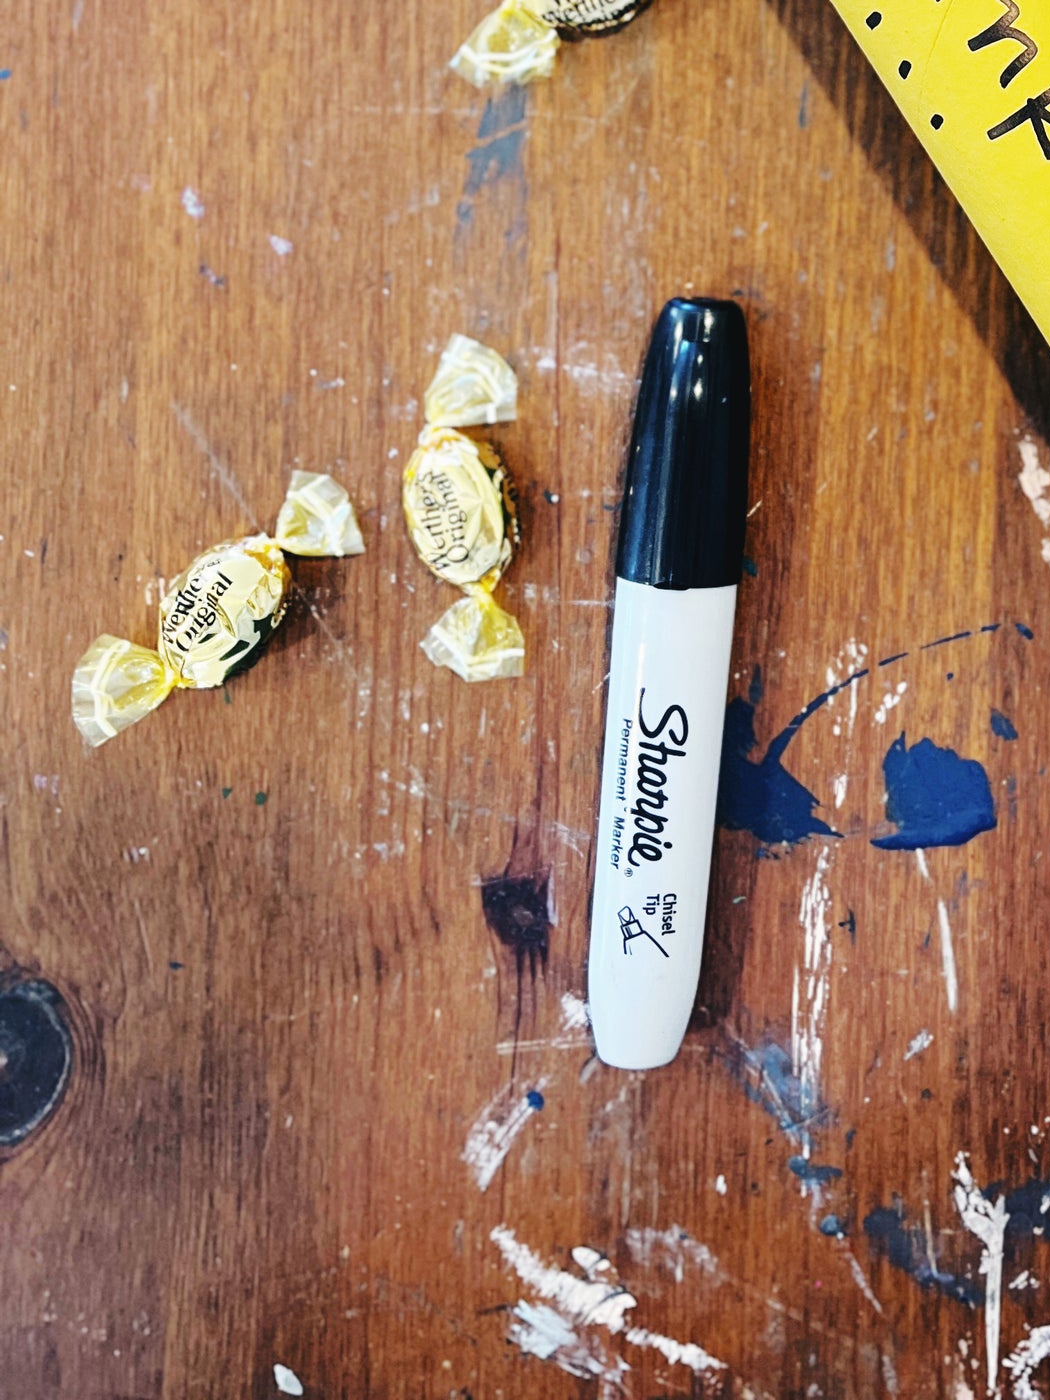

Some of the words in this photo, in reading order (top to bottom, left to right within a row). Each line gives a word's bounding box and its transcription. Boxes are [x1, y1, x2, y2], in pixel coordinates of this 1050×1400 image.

[432, 472, 470, 563] Original
[615, 718, 632, 802] Permanent
[628, 687, 689, 867] Sharpie
[610, 815, 625, 870] Marker
[642, 893, 660, 916] Tip
[661, 892, 677, 936] Chisel
